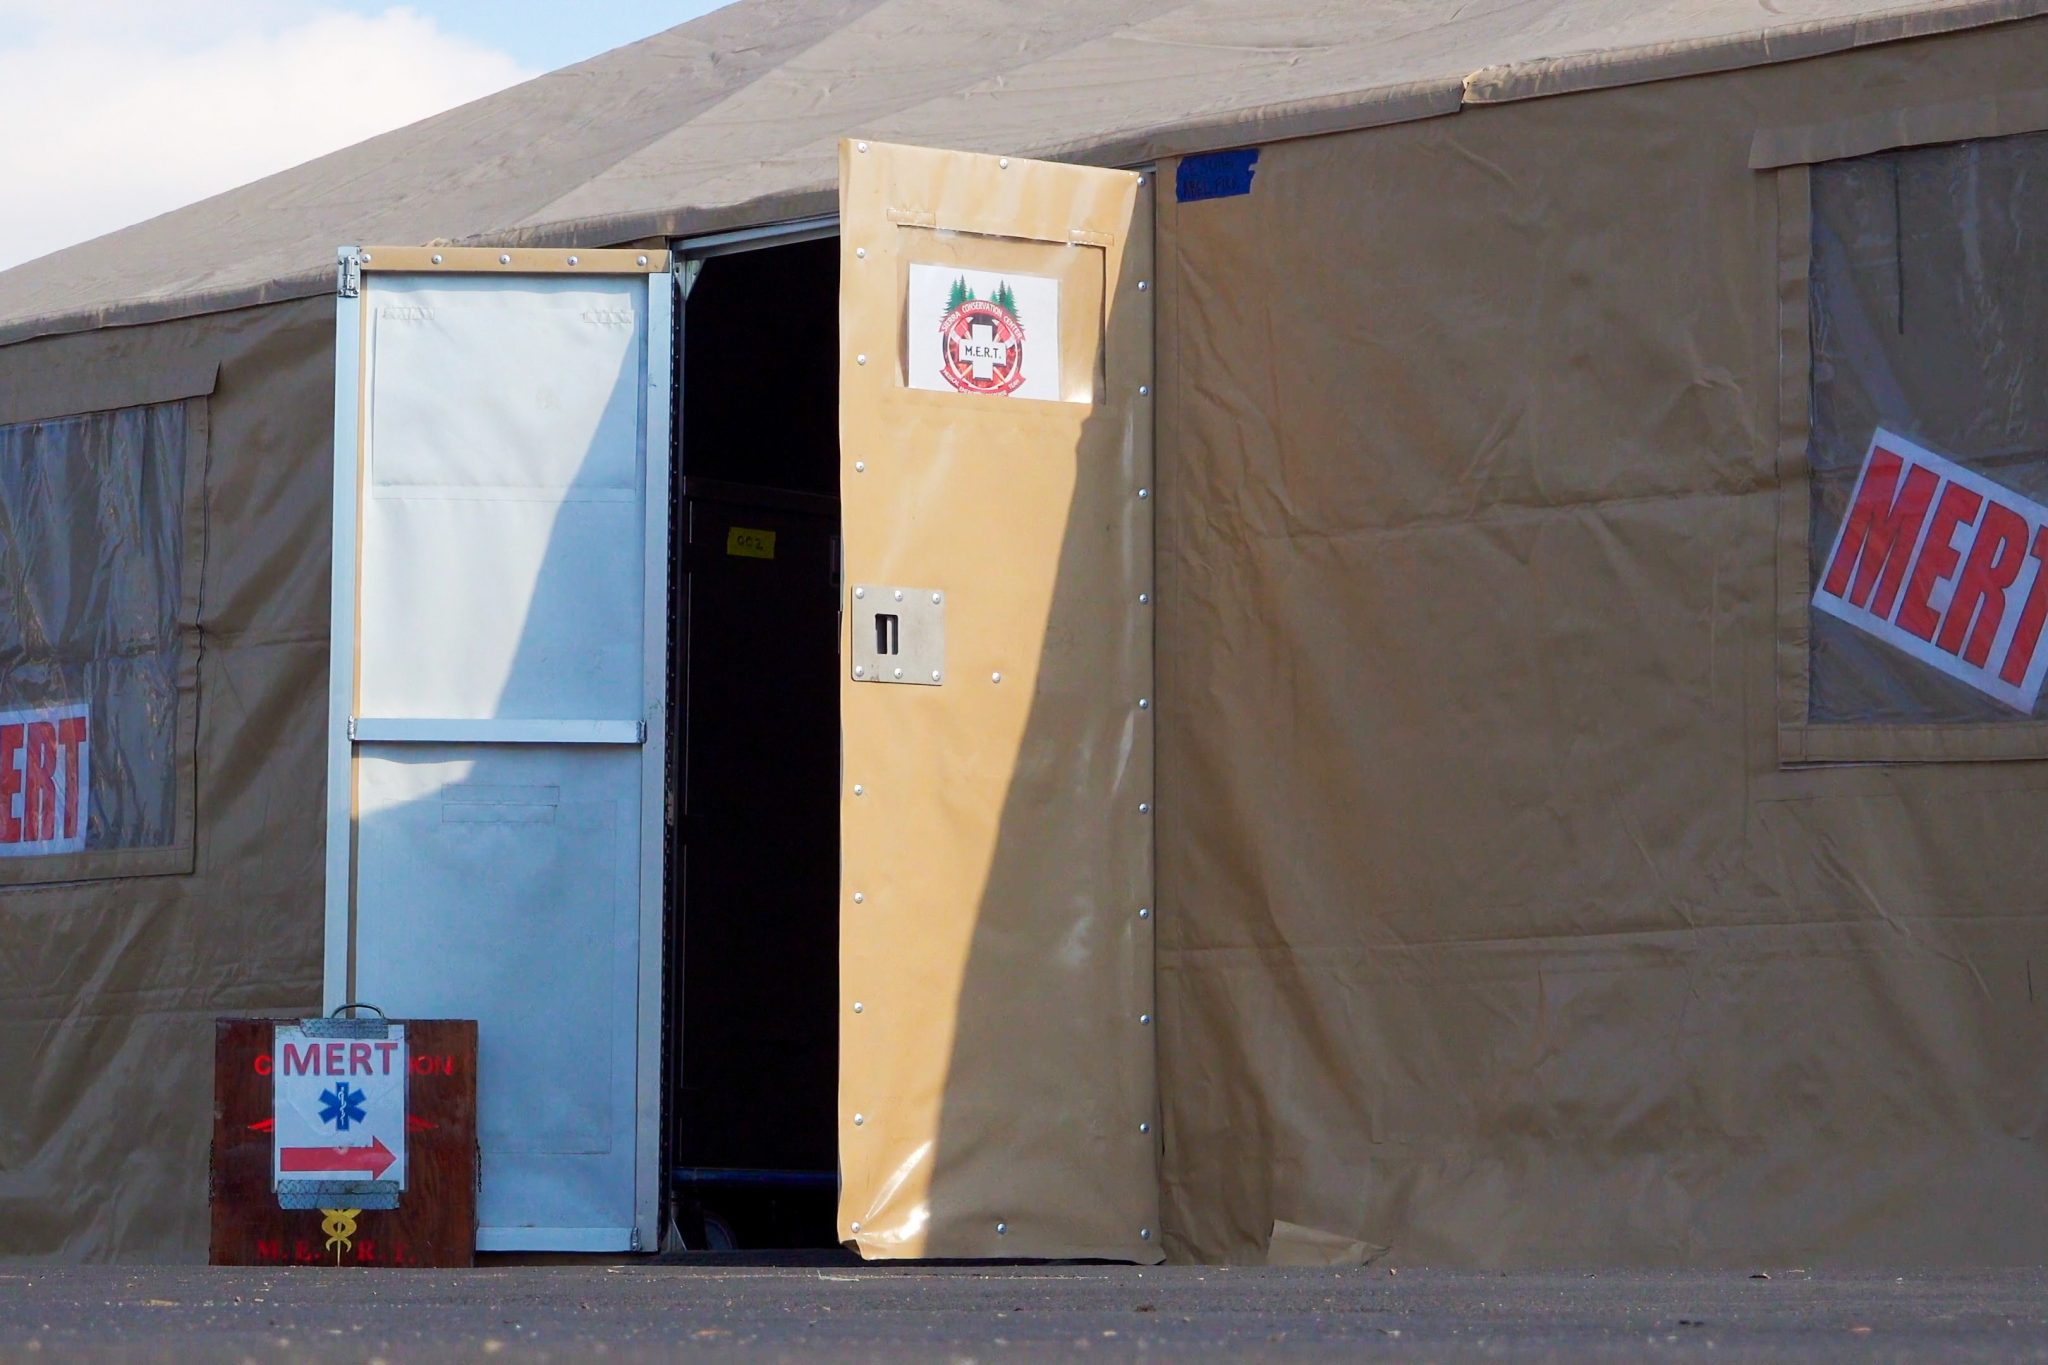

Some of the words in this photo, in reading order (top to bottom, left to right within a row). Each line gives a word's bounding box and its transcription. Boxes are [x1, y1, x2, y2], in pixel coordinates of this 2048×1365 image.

[942, 311, 961, 332] SIERRA
[961, 302, 1003, 318] CONSERVATION
[1003, 315, 1023, 339] CENTER
[965, 345, 1002, 359] M.E.R.T.
[283, 1042, 398, 1076] MERT
